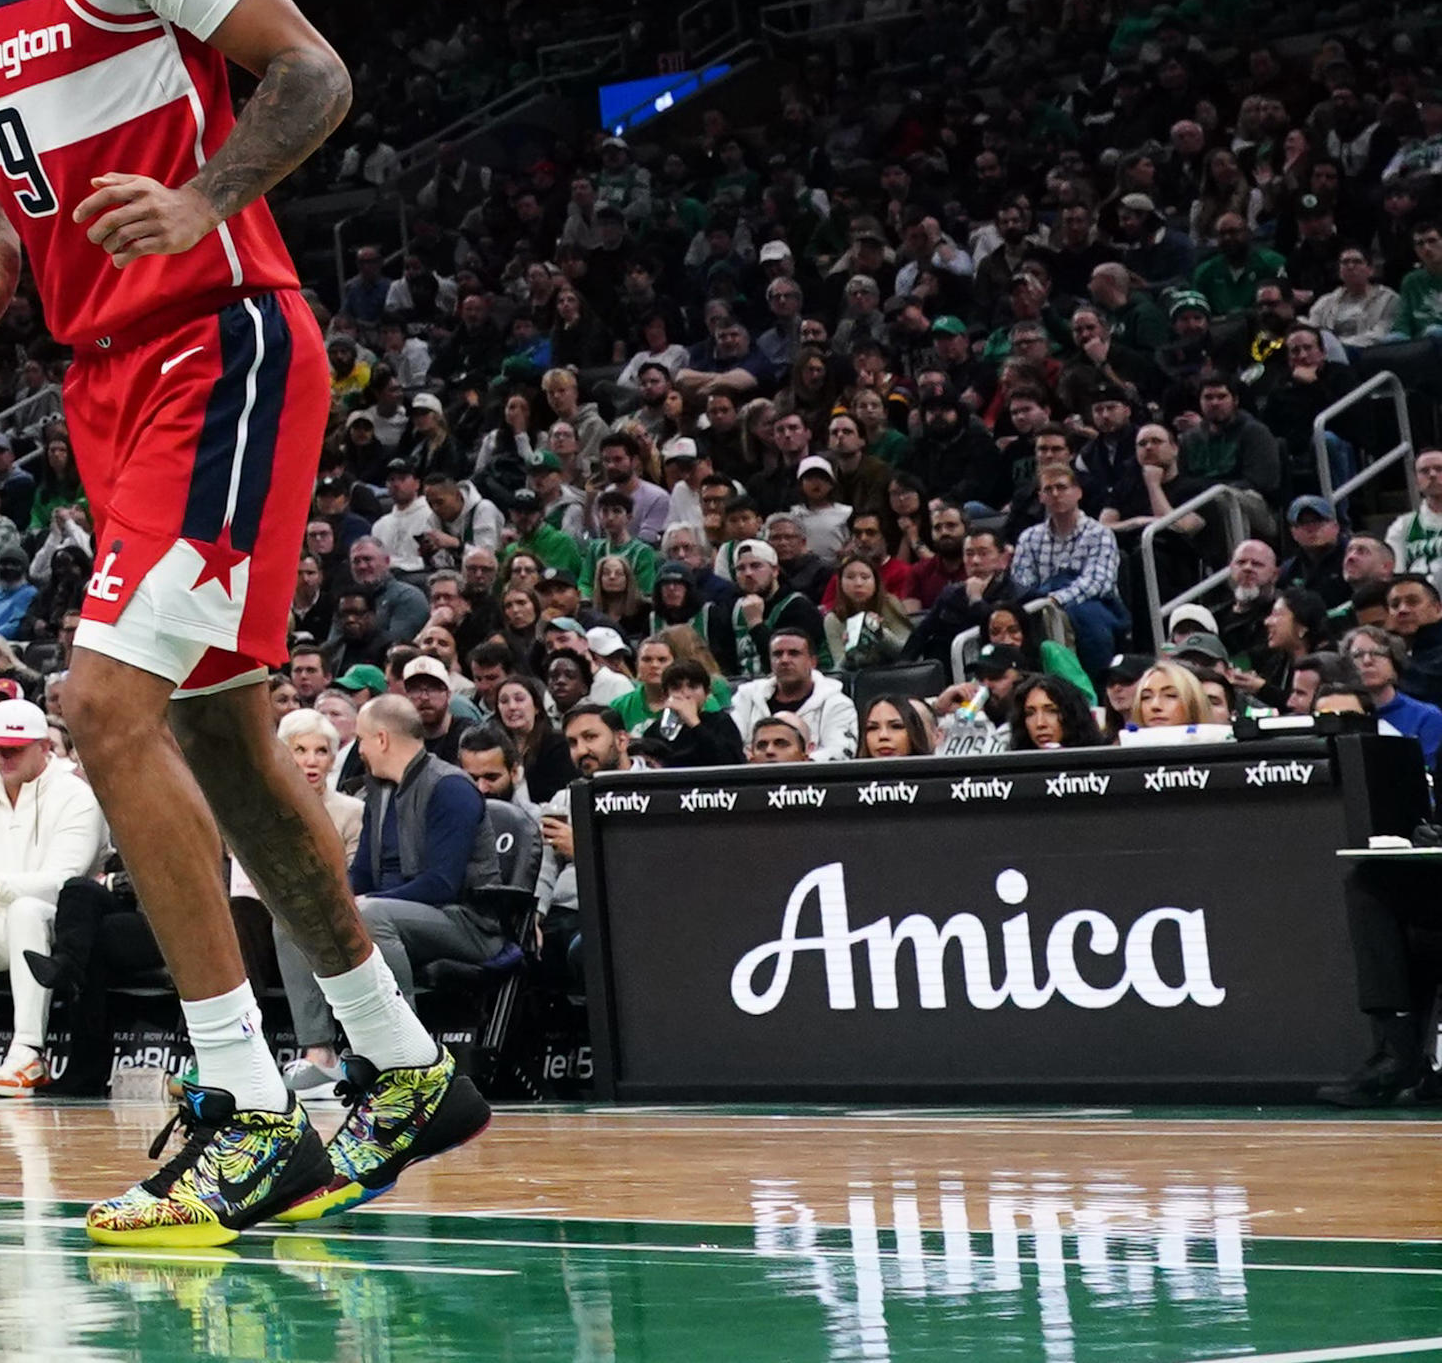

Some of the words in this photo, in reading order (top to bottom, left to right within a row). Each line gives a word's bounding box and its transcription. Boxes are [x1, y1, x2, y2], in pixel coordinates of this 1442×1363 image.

[1045, 772, 1110, 796] xfinity
[1144, 766, 1211, 792] xfinity
[1245, 760, 1314, 787] xfinity
[680, 788, 738, 812] xfinity
[767, 784, 827, 809] xfinity
[857, 780, 919, 805] xfinity
[950, 777, 1014, 801] xfinity
[594, 791, 651, 814] xfinity
[731, 862, 1225, 1015] Amica
